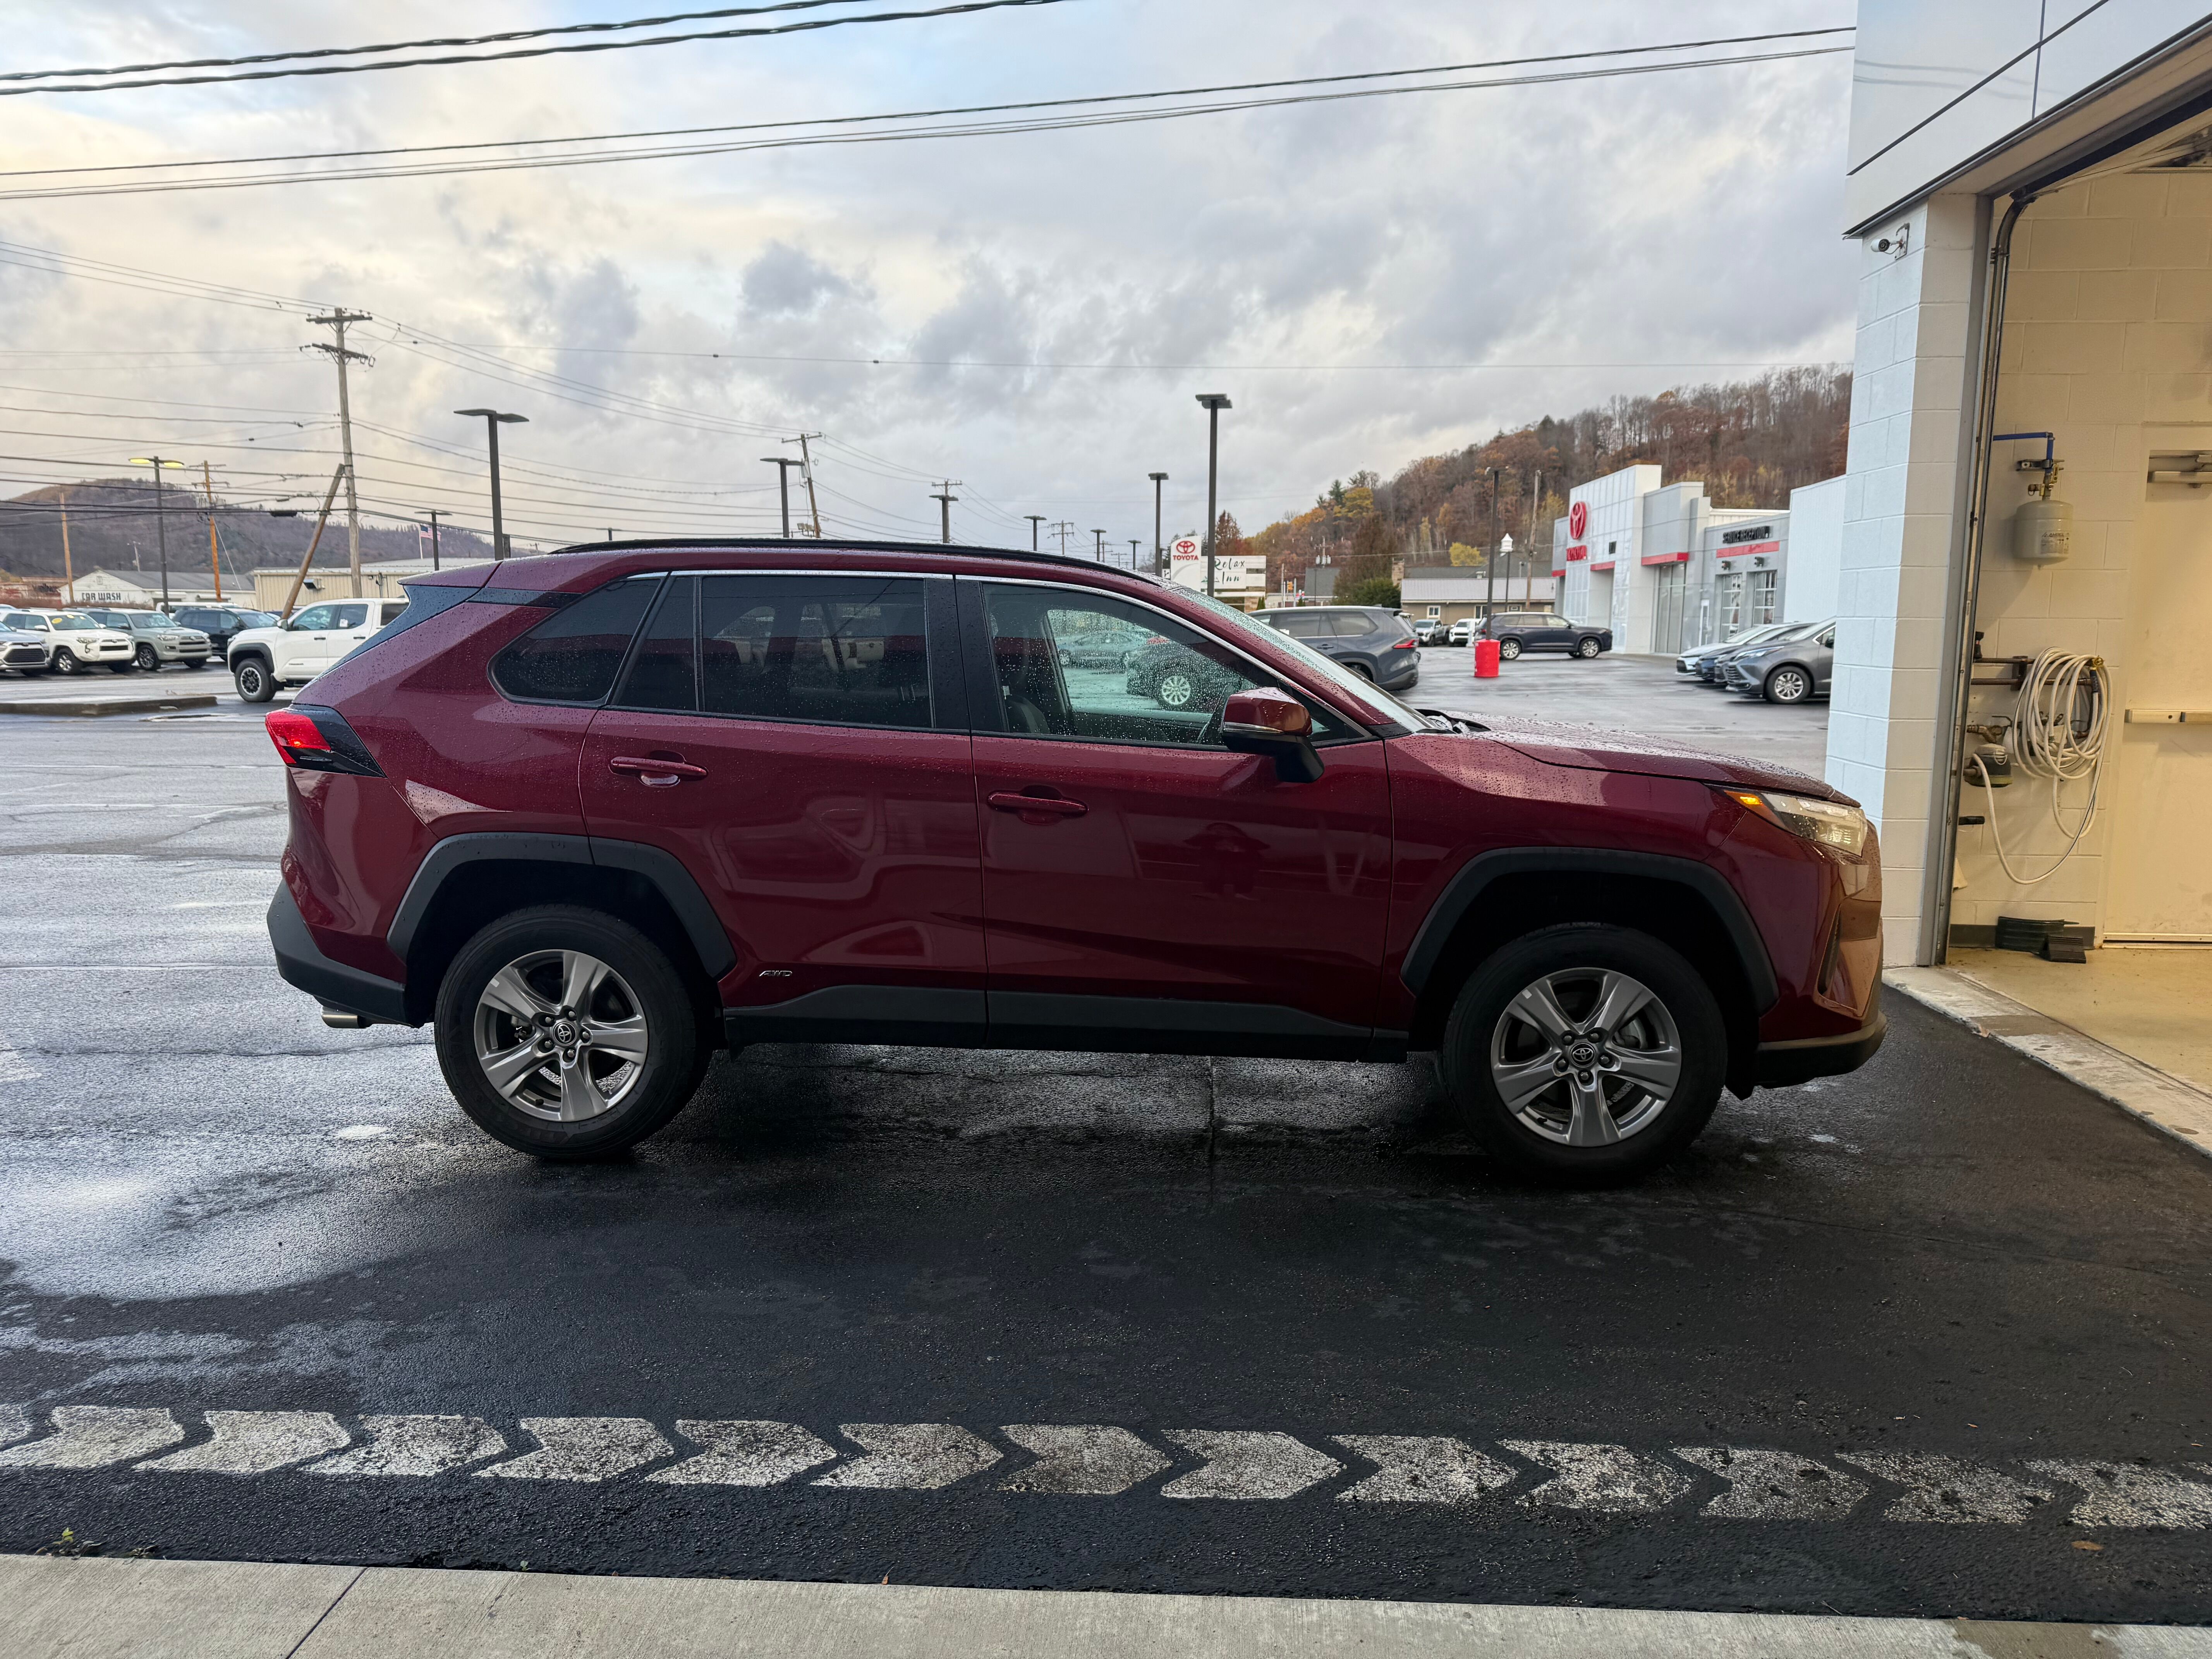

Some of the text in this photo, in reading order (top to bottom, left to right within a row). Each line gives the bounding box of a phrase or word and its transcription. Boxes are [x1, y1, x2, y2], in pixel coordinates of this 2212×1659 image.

[1723, 526, 1770, 544] SERVICE RECEPTION
[1214, 558, 1245, 570] Relax
[1222, 571, 1240, 584] Inn
[82, 592, 121, 601] CAR WASH
